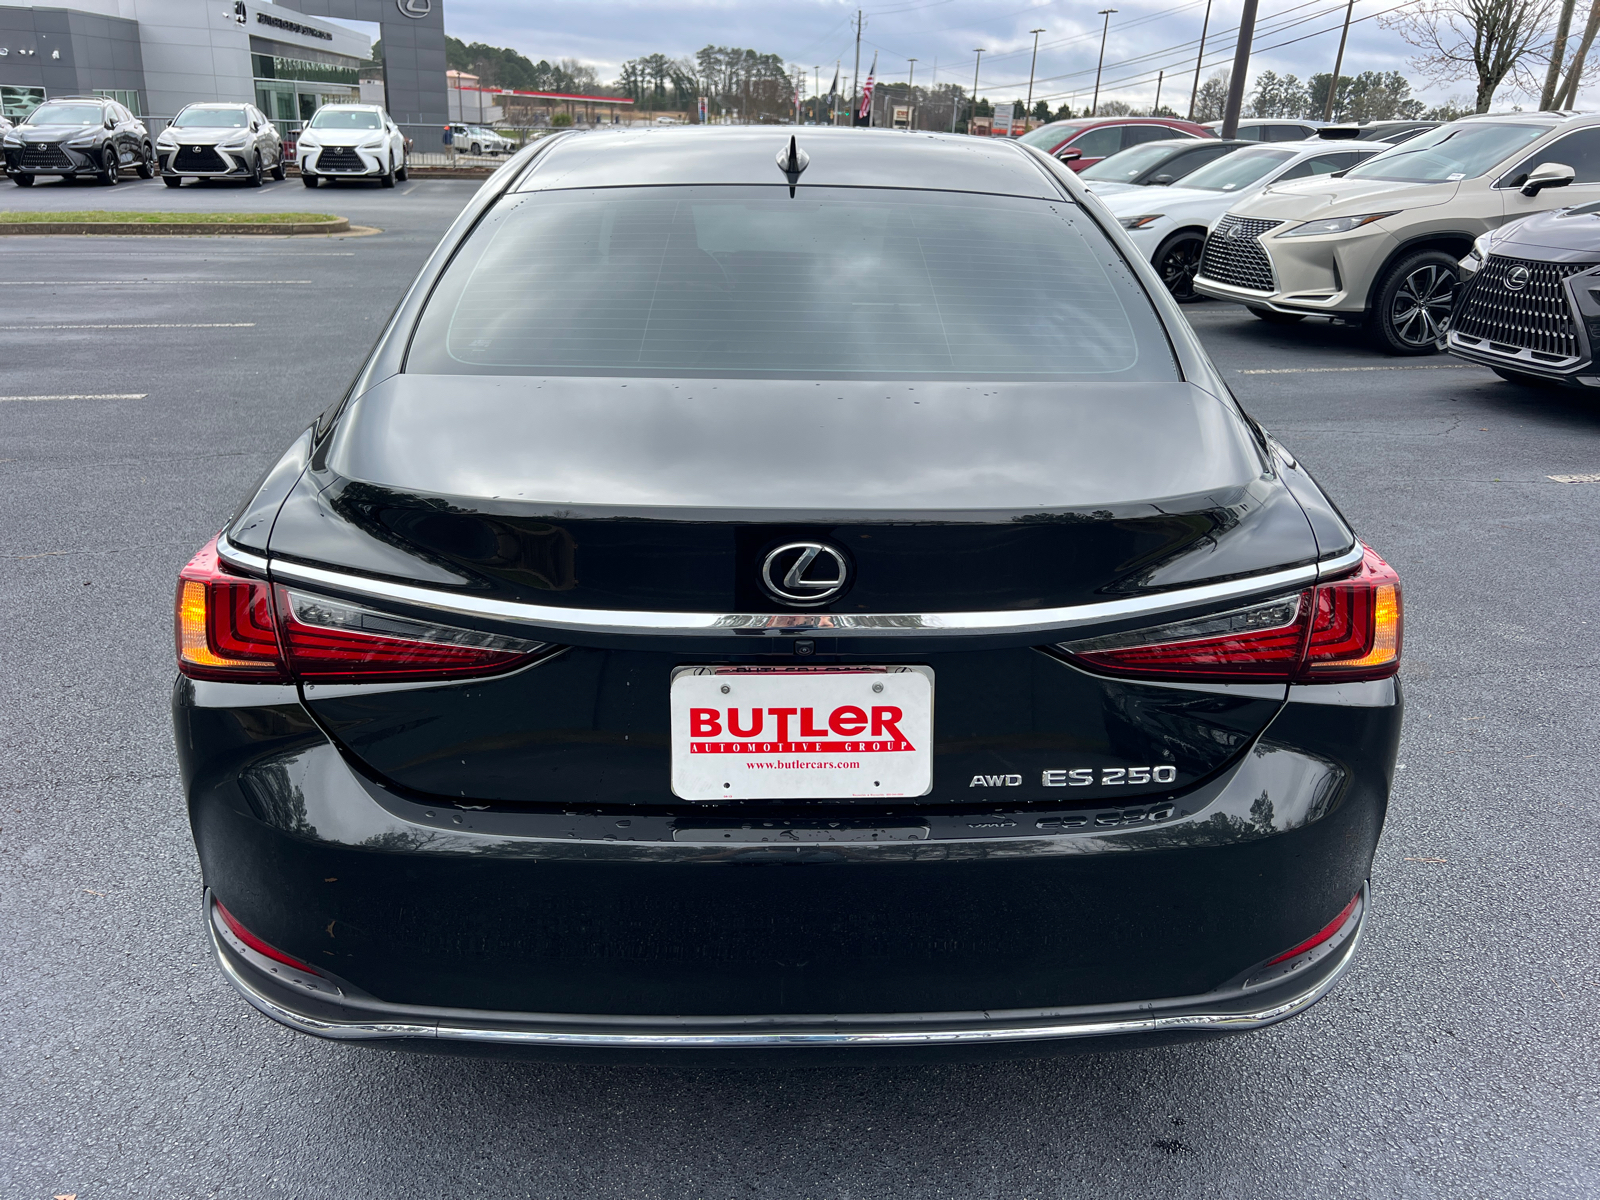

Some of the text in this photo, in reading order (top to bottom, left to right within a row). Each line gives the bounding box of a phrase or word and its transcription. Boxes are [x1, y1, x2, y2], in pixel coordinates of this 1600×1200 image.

[691, 741, 907, 753] AUTOMOTIVE GROUP
[746, 760, 860, 770] www.butlercars.com
[969, 765, 1177, 788] AWD ES 250
